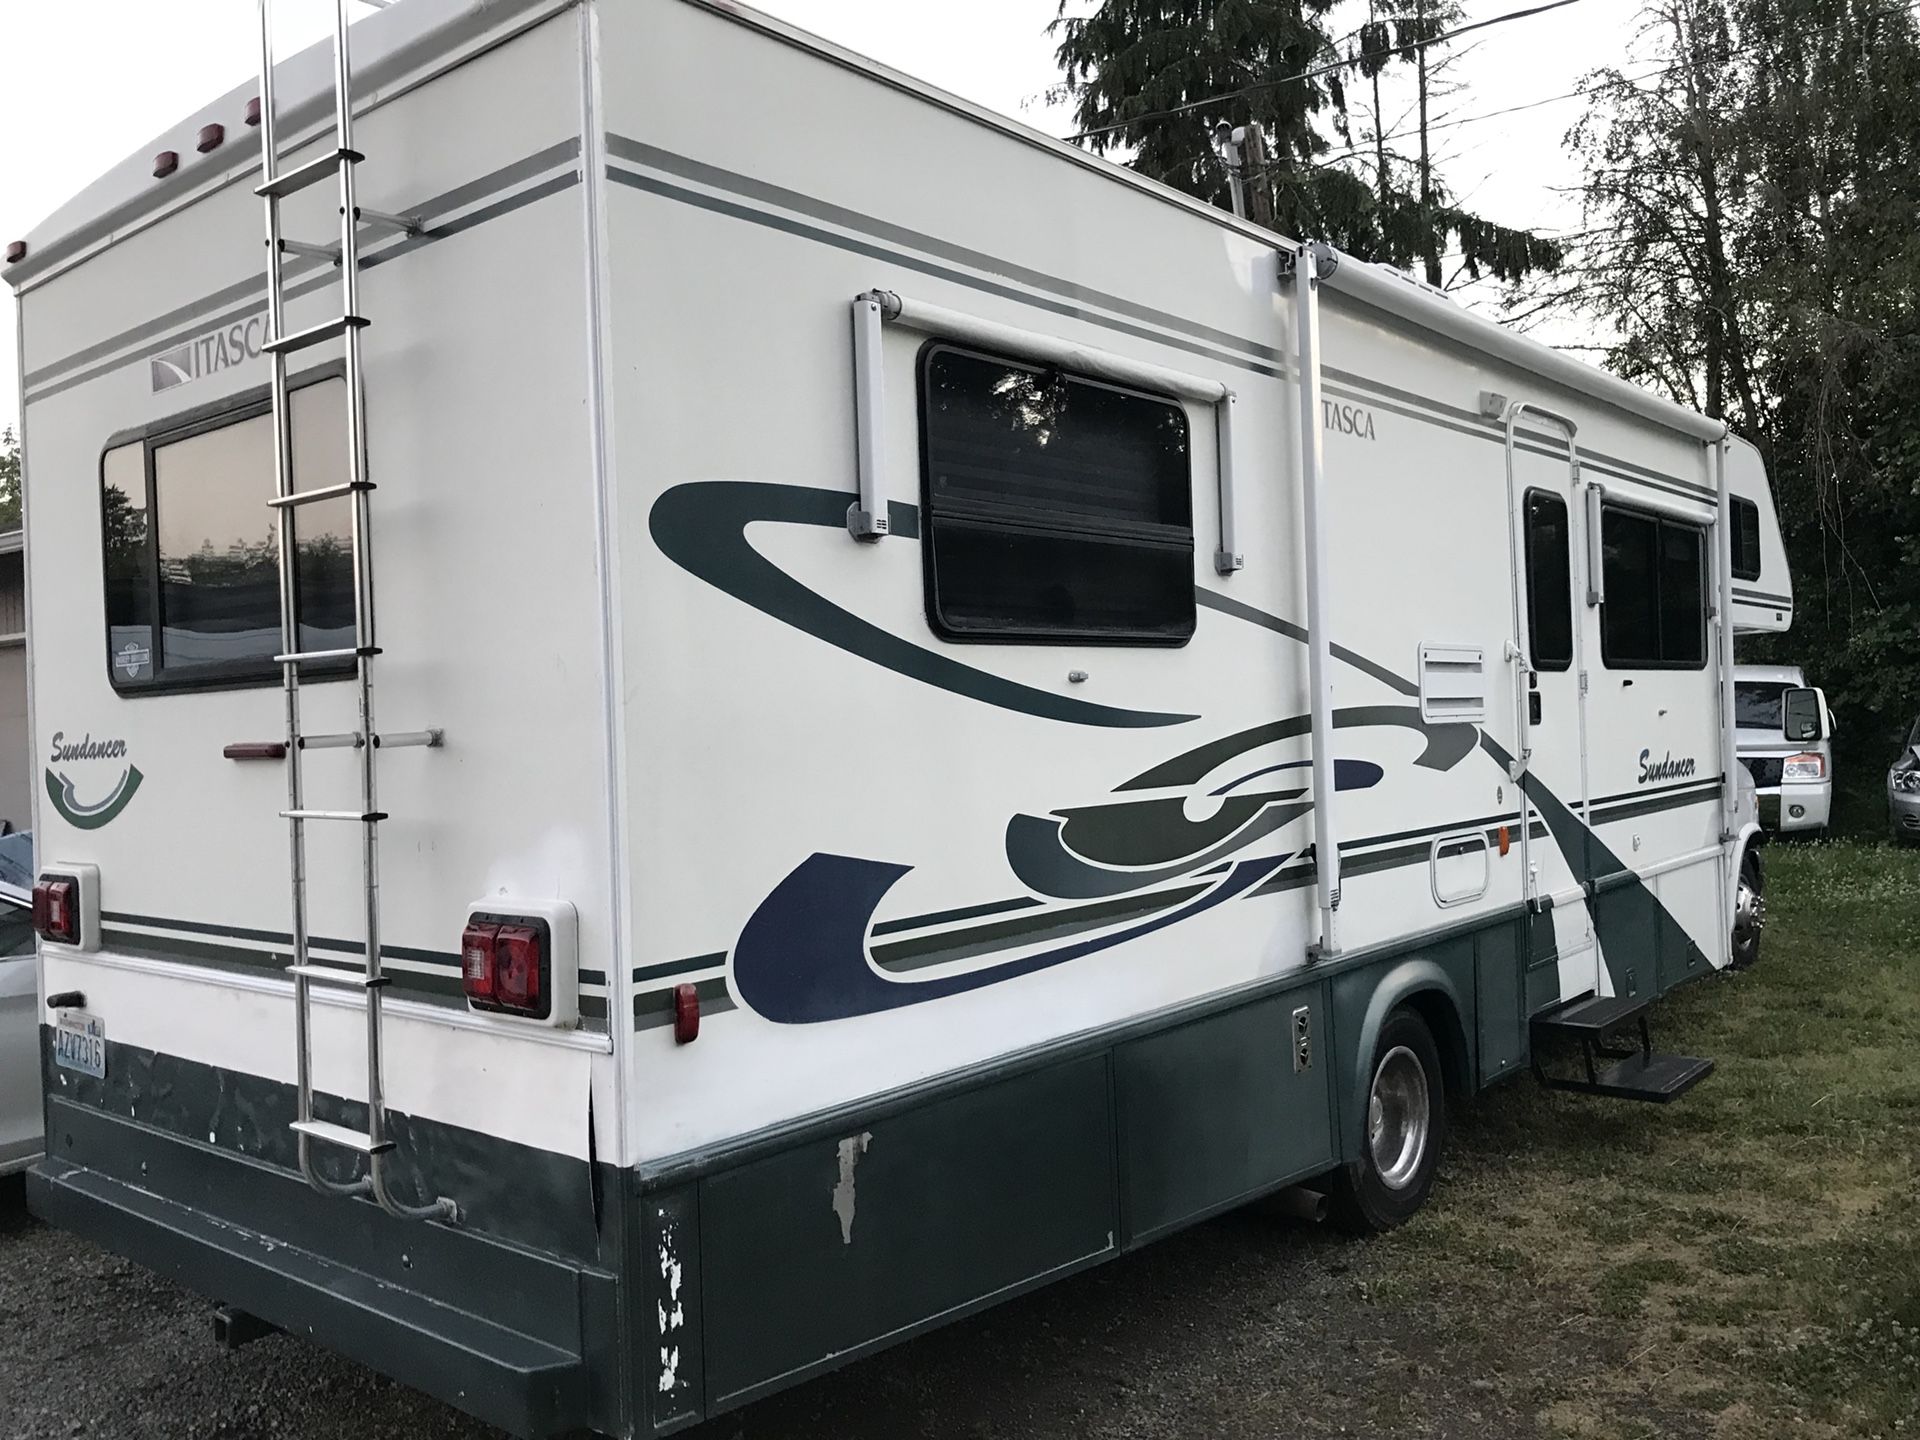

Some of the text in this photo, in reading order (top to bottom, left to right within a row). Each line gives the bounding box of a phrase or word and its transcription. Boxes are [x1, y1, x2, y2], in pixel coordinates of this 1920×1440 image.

[1321, 399, 1376, 441] TASCA
[51, 731, 127, 762] Sundancer
[1638, 748, 1695, 784] Sundancer
